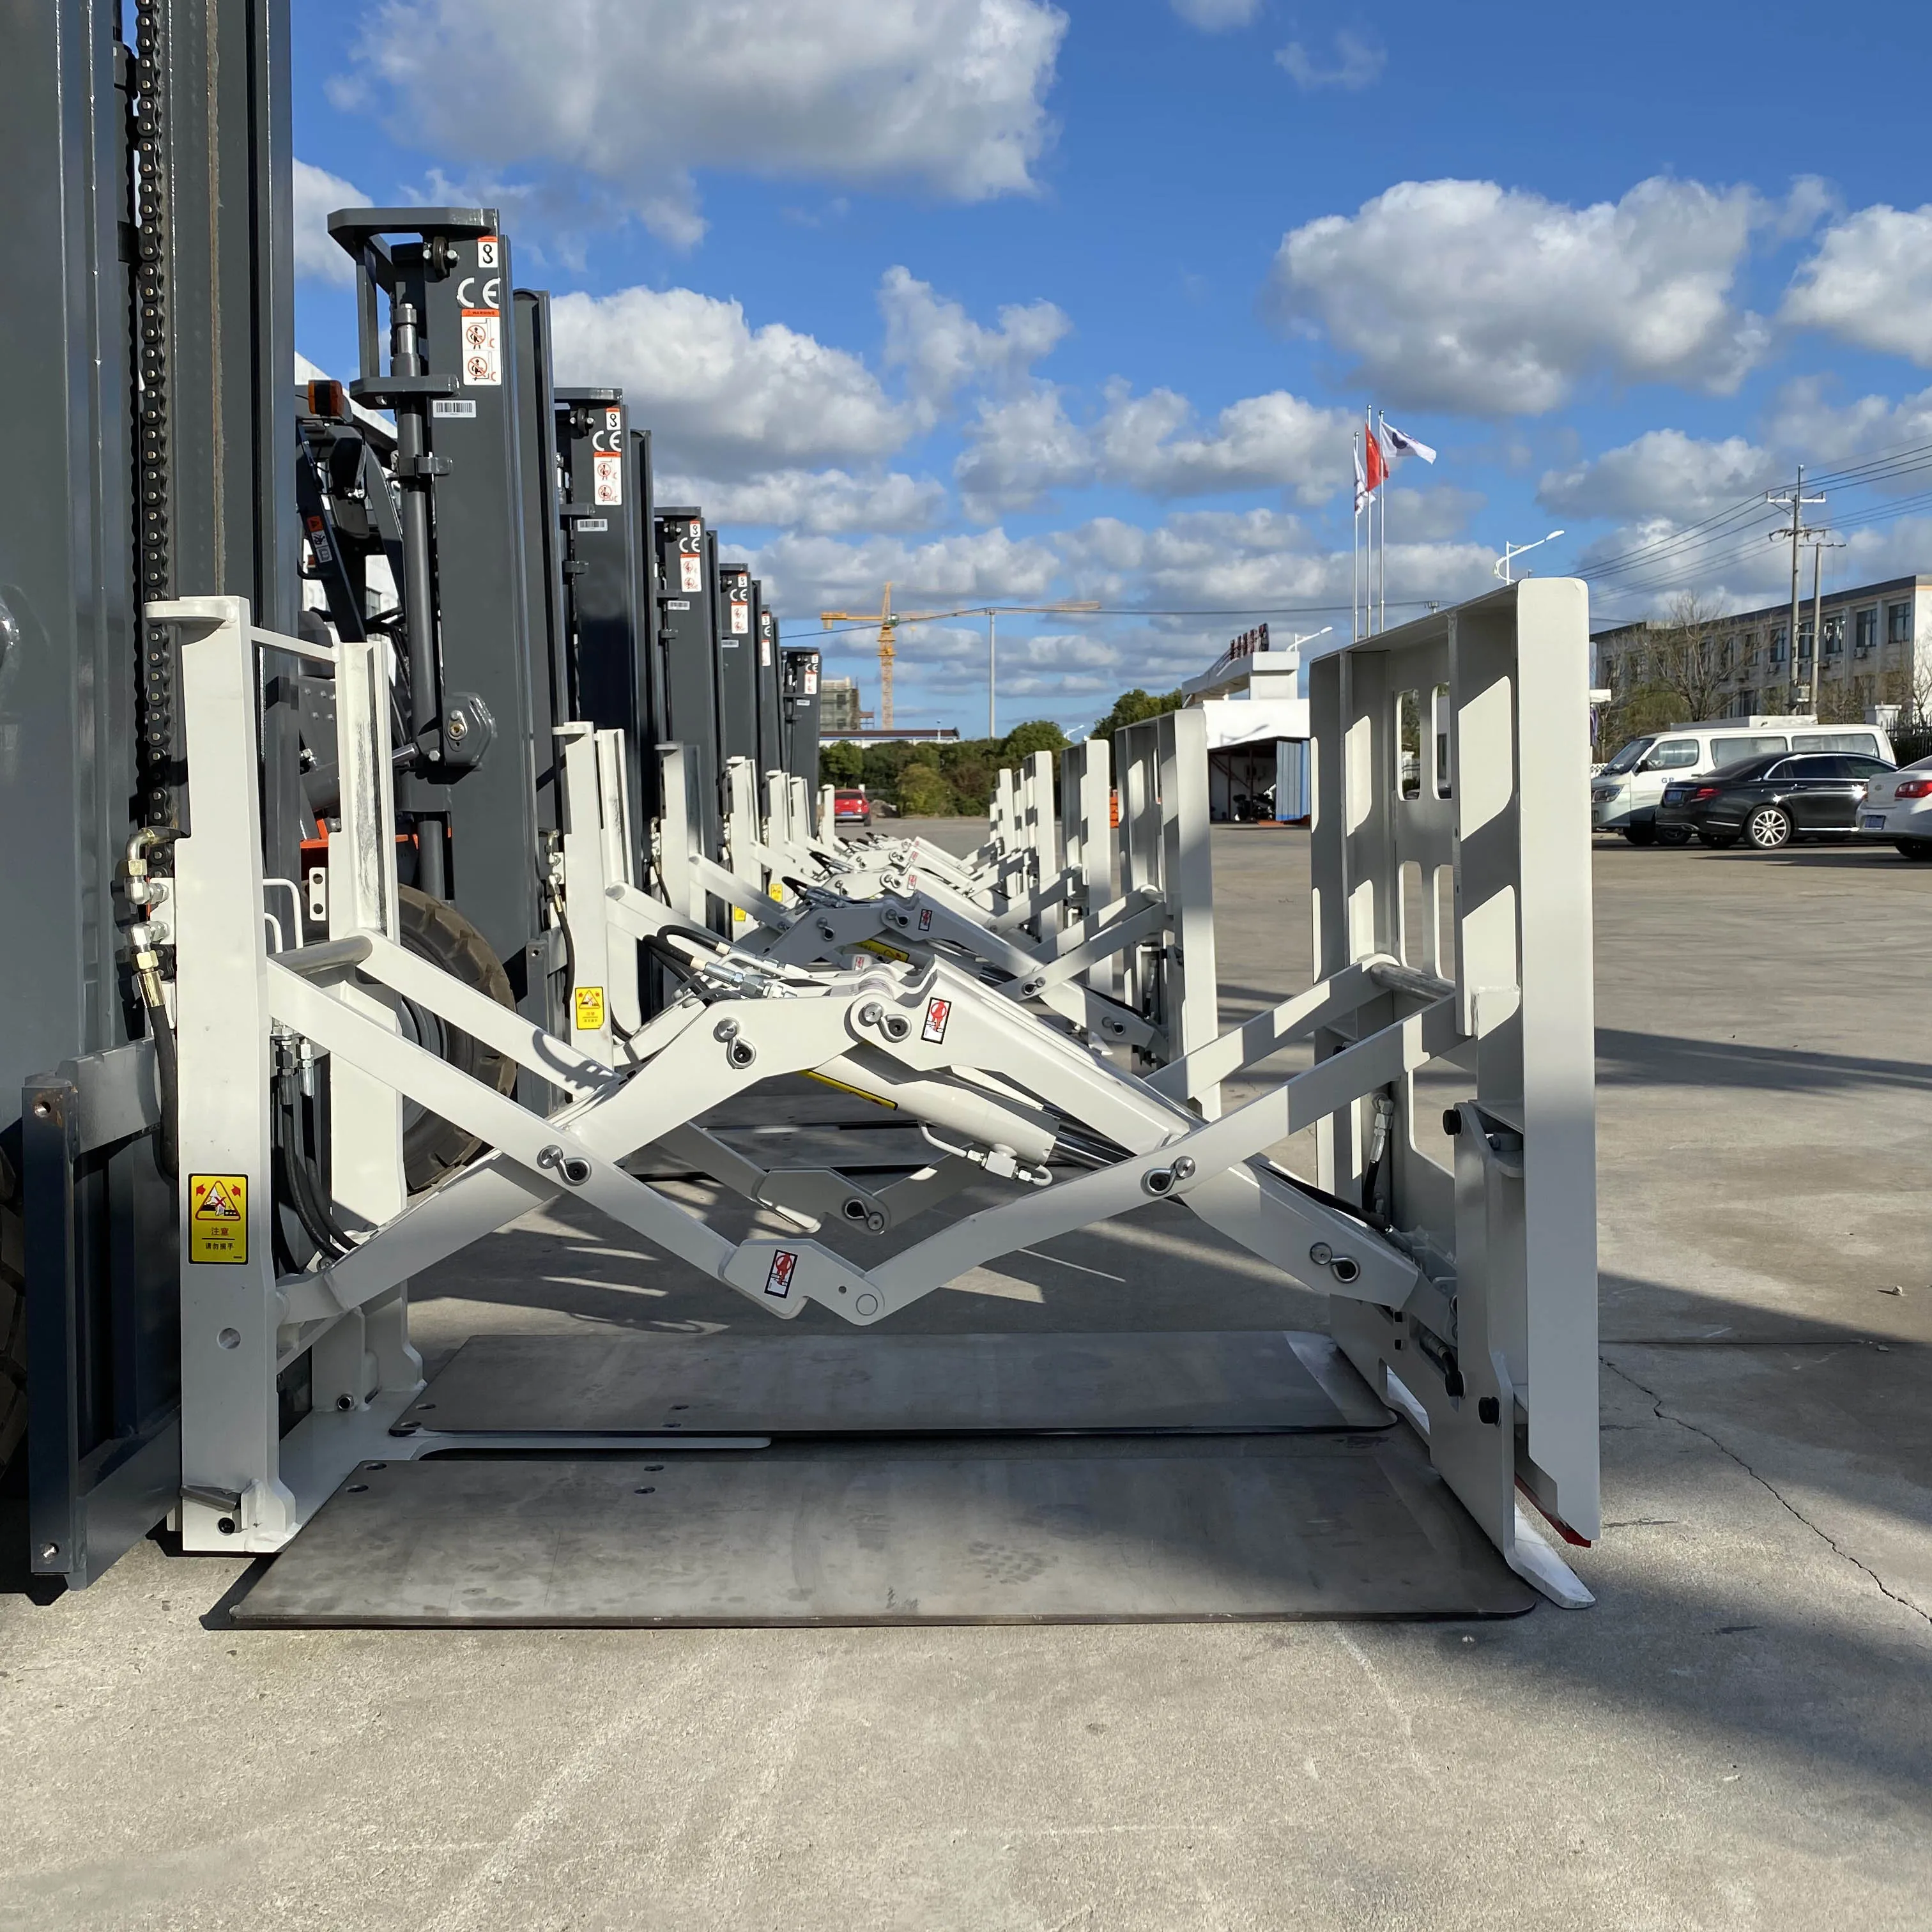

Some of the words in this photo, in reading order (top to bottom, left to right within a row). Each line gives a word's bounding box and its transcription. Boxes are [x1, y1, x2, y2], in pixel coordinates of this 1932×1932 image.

[457, 277, 501, 309] CE
[592, 430, 622, 452] CE
[678, 537, 701, 553] CE
[211, 1227, 229, 1236] 注意
